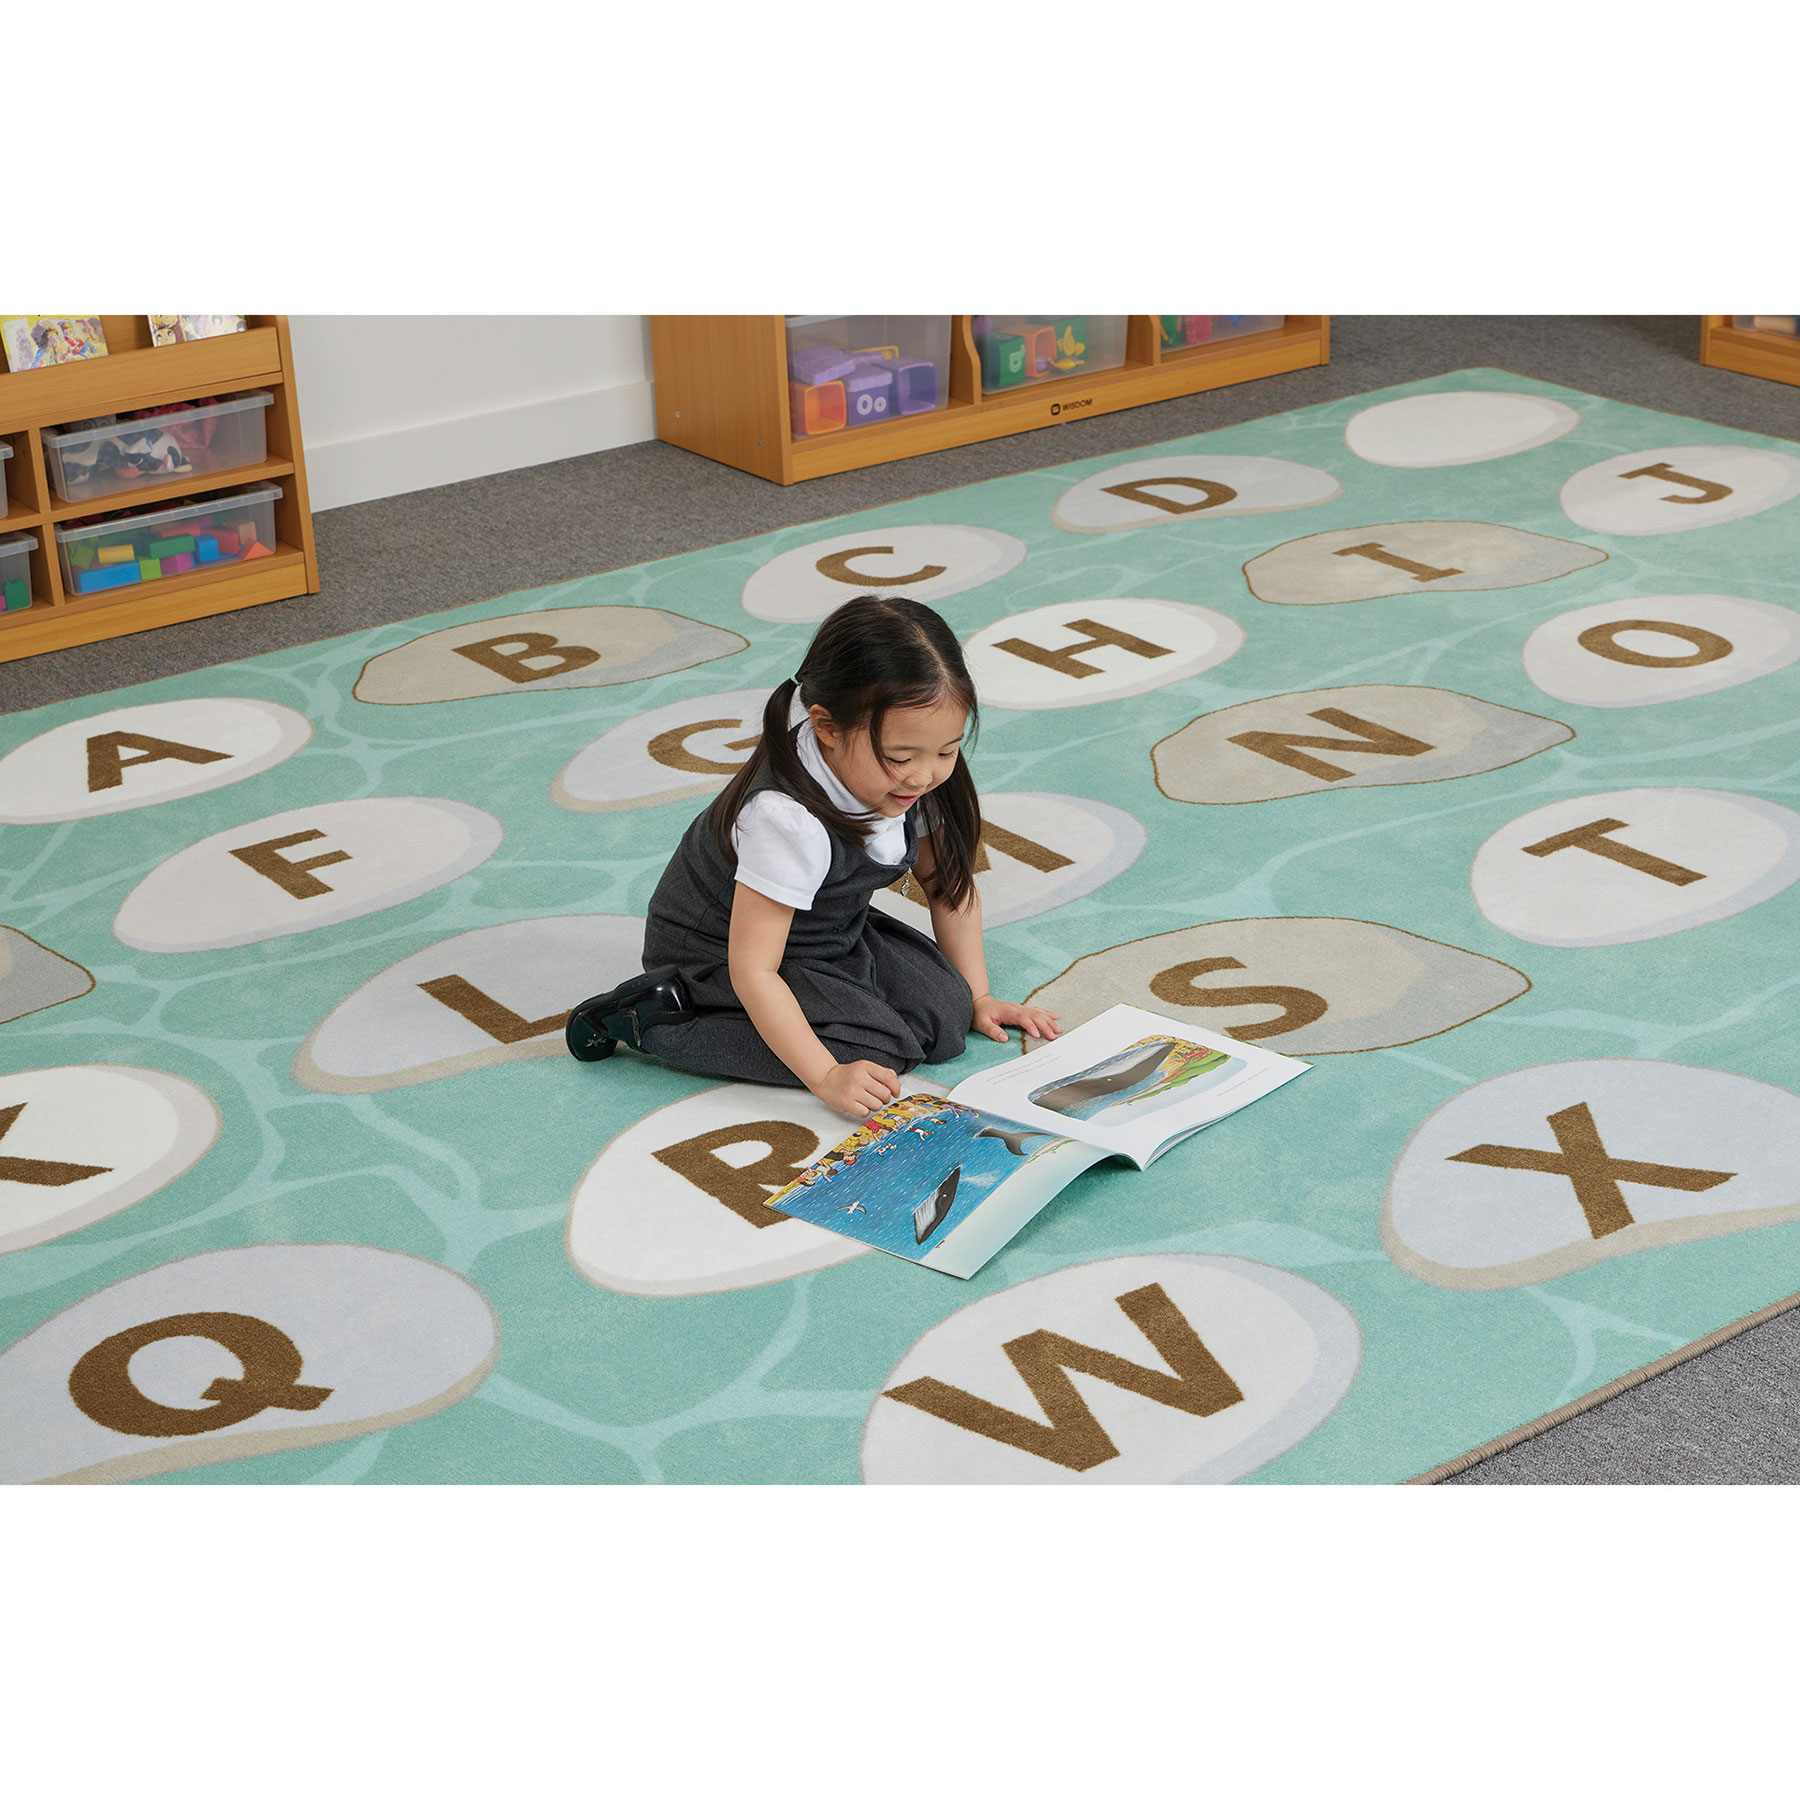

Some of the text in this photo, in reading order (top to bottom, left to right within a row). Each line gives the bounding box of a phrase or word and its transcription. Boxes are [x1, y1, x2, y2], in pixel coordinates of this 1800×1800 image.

[856, 394, 887, 415] Oo
[1062, 398, 1093, 411] WISDOM
[1103, 479, 1239, 516] D
[1620, 464, 1734, 505] J
[817, 547, 948, 588] C
[1332, 543, 1465, 584] I
[451, 633, 604, 686] B
[993, 620, 1175, 680] H
[1579, 621, 1735, 669] O
[87, 732, 234, 793] A
[647, 718, 764, 775] G
[1227, 709, 1438, 784] N
[229, 830, 353, 901] F
[1523, 819, 1708, 888] T
[416, 973, 574, 1045] L
[1150, 958, 1330, 1040] S
[651, 1120, 820, 1230] R
[1447, 1103, 1738, 1241] X
[69, 1313, 335, 1439] Q
[883, 1283, 1245, 1474] W
